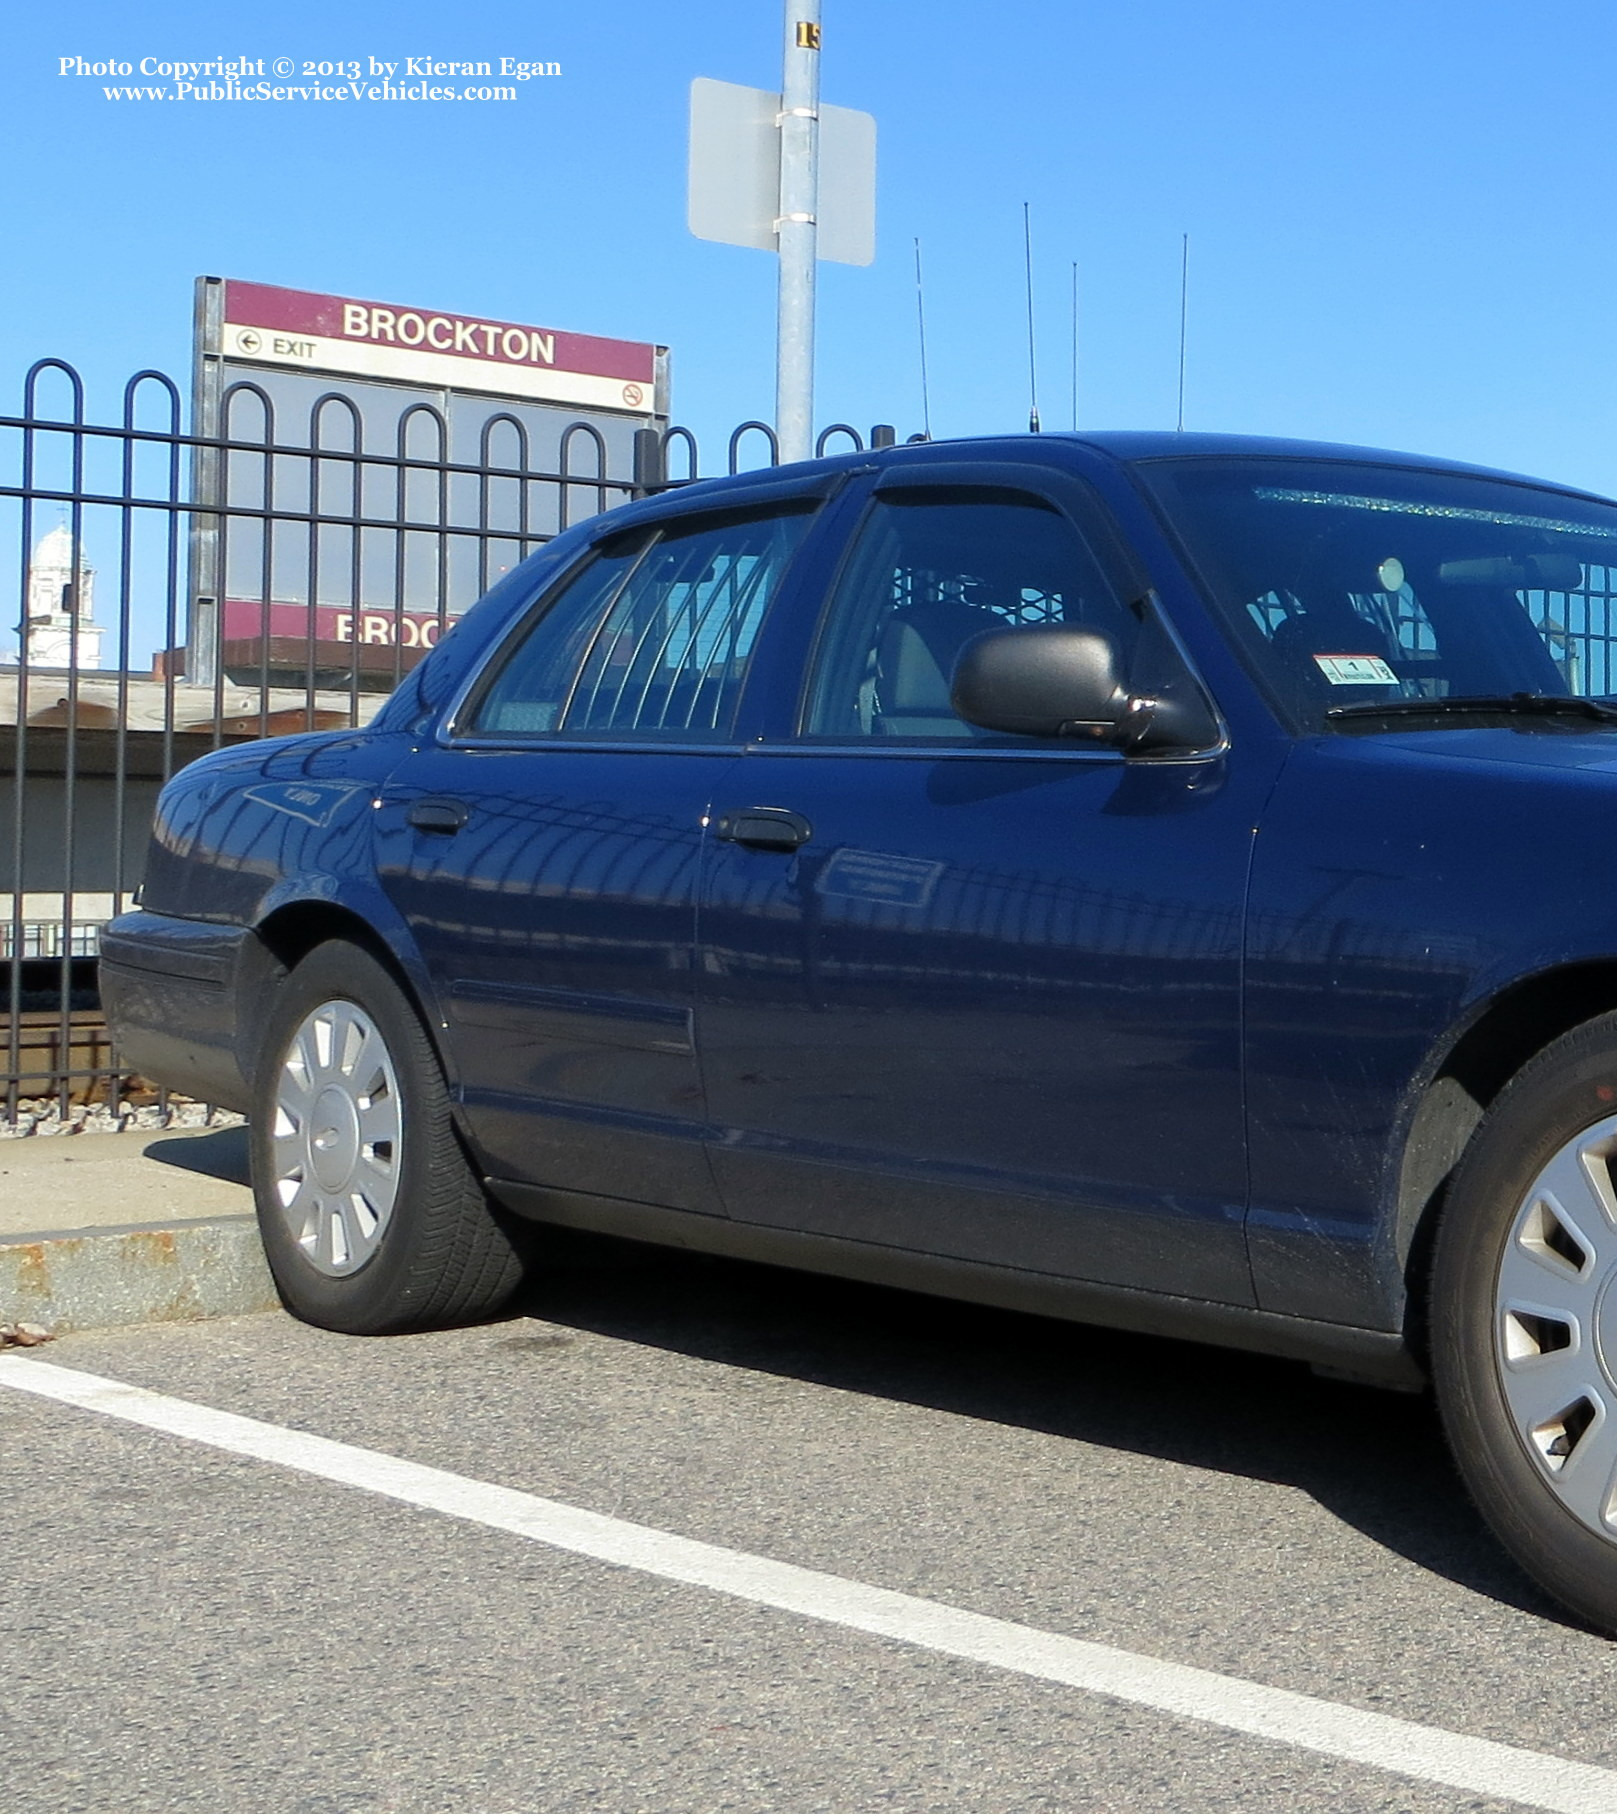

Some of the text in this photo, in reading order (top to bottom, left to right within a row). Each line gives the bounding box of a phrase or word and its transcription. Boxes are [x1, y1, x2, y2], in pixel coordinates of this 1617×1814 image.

[273, 337, 317, 359] EXIT
[343, 303, 555, 364] BROCKTON
[336, 613, 456, 649] BROC
